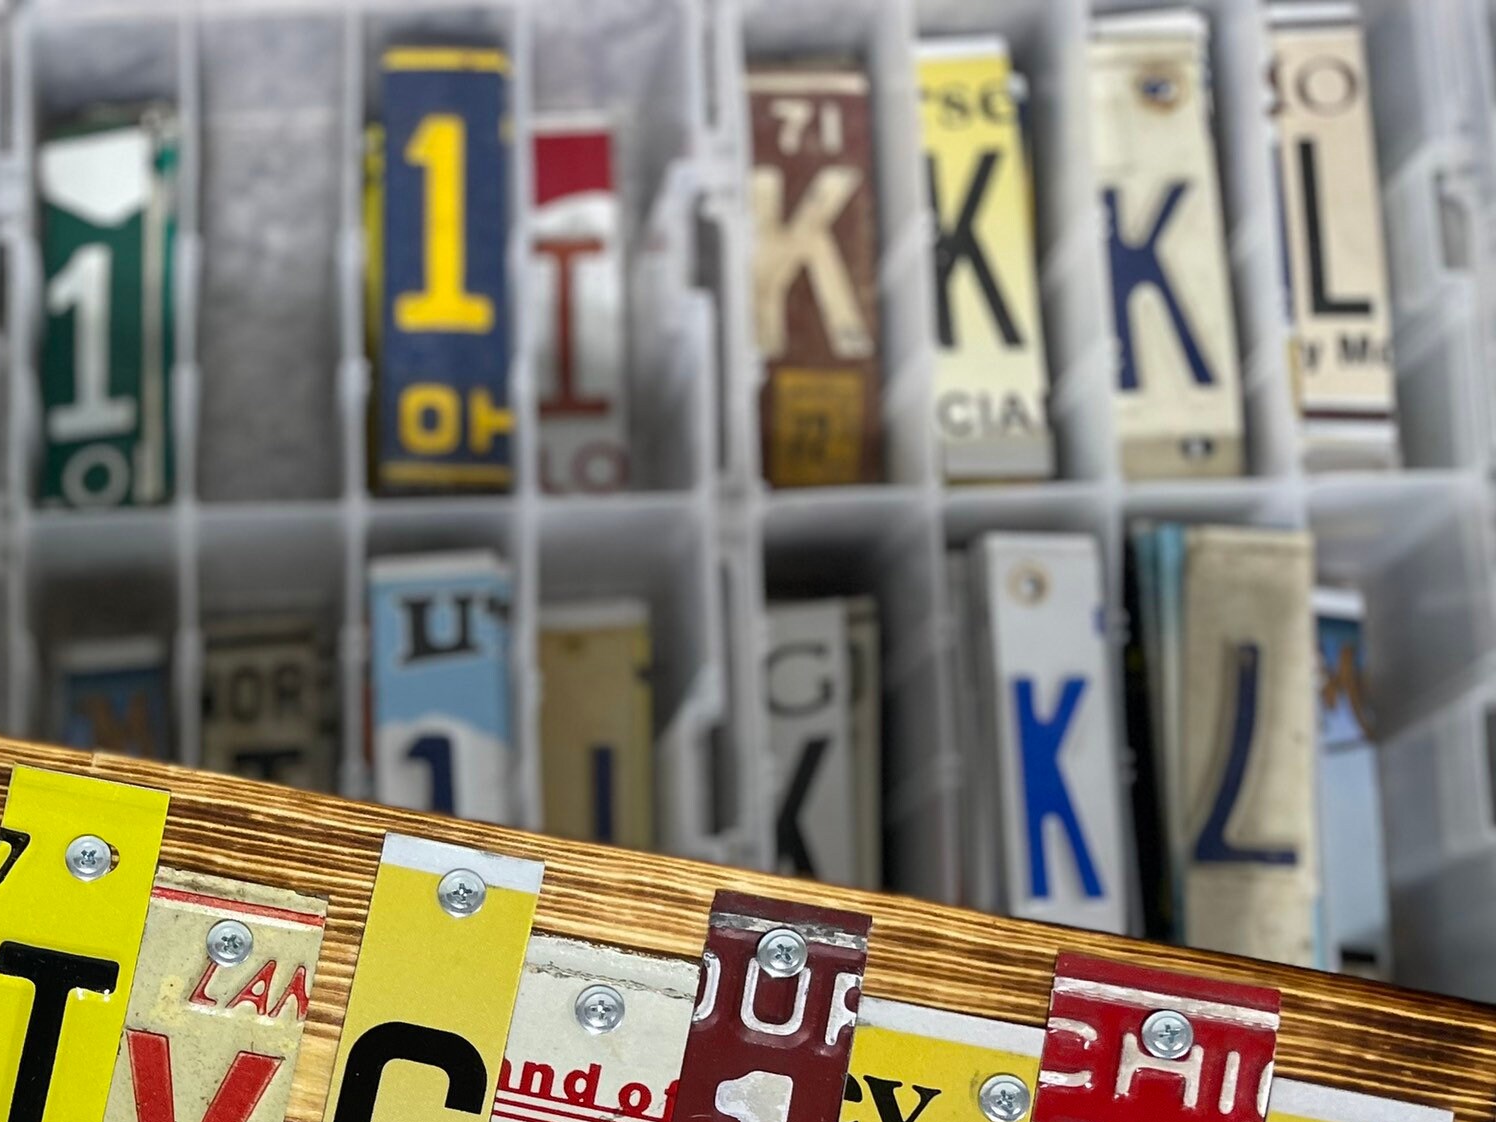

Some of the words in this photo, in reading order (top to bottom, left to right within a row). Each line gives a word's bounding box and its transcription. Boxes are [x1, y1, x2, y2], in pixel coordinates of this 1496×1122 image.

[393, 112, 496, 334] 1
[767, 98, 844, 157] 71
[1298, 136, 1377, 318] L
[47, 240, 137, 443] 1
[750, 163, 875, 360] K
[924, 148, 1028, 350] K
[1100, 178, 1216, 392] K
[1012, 674, 1104, 900] K
